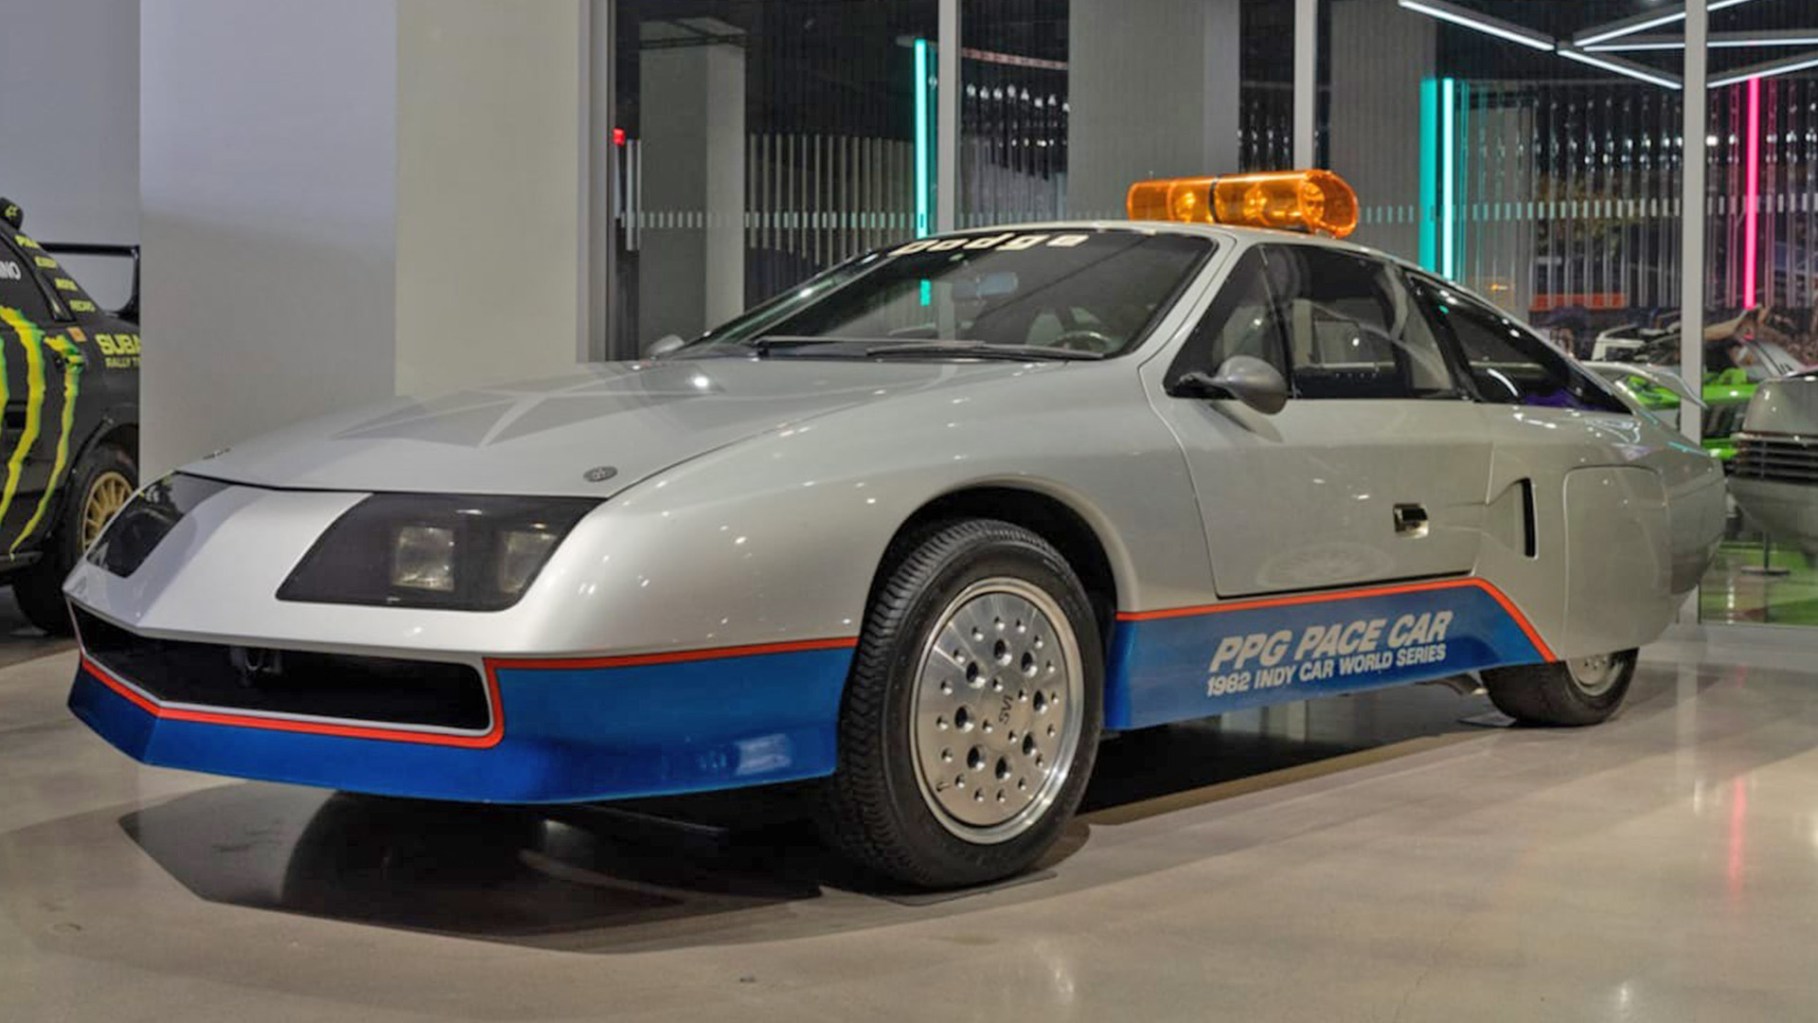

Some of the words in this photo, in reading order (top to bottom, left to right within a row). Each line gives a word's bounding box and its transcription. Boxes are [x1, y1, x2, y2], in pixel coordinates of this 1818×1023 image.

[887, 233, 1089, 256] Dodge
[1209, 630, 1293, 673] PPG
[1294, 618, 1388, 661] PACE
[1387, 611, 1454, 648] CAR
[1206, 672, 1251, 697] 1982
[1254, 665, 1297, 689] INDY
[1300, 660, 1334, 681] CAR
[1339, 651, 1392, 675] WORLD
[1396, 644, 1447, 667] SERIES
